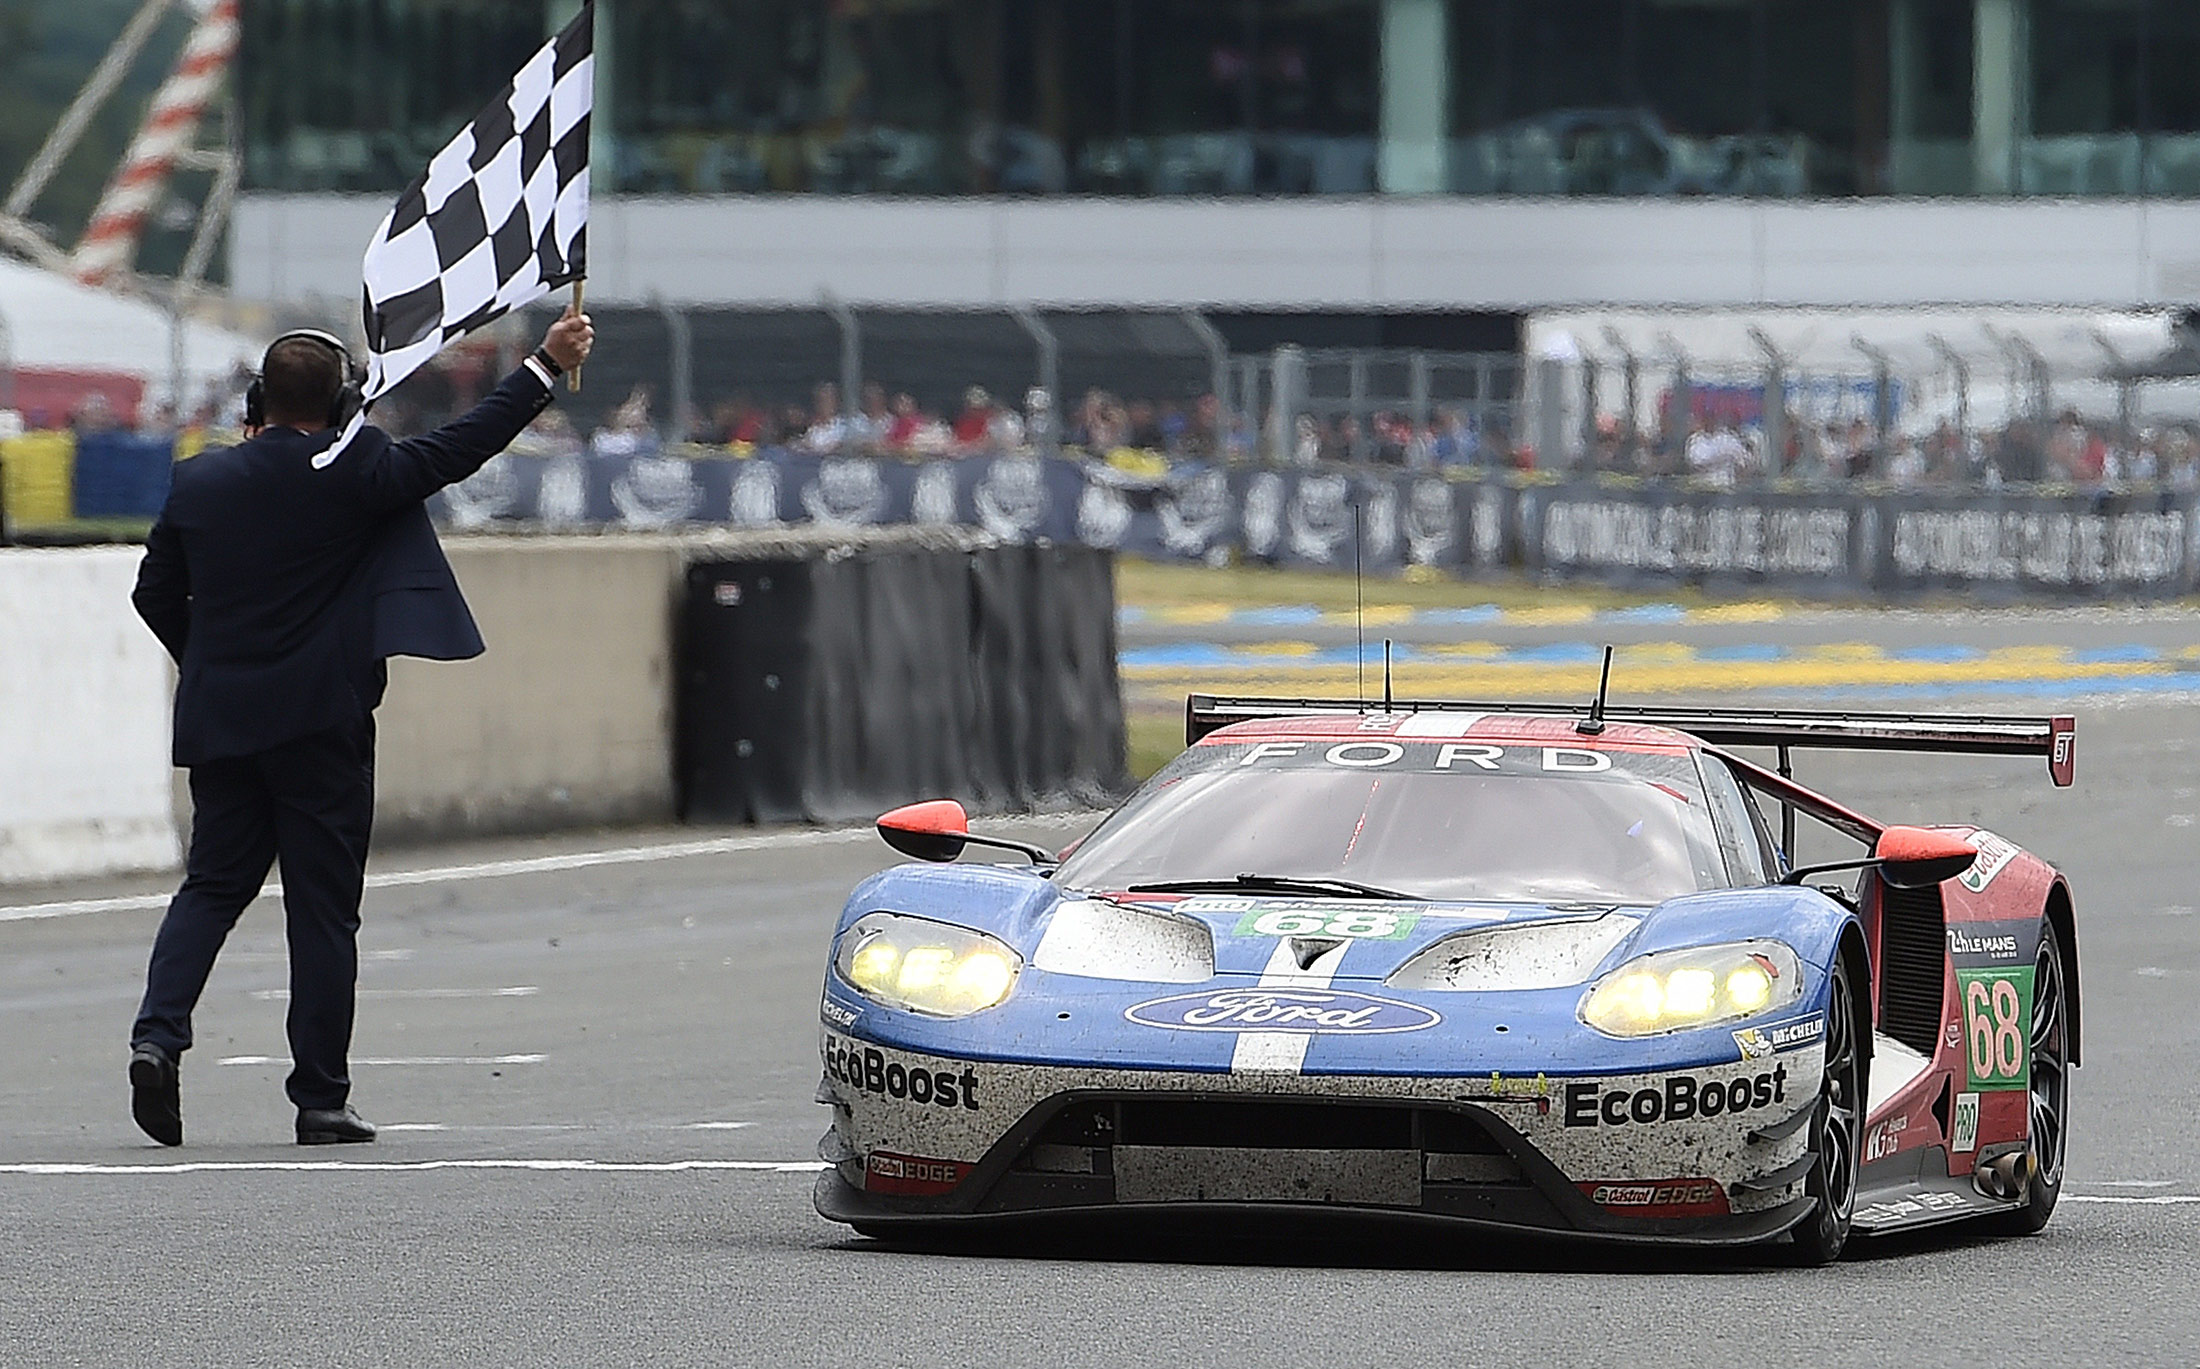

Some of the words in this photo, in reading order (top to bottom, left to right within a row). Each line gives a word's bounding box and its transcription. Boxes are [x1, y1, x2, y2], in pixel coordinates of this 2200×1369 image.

[1239, 741, 1613, 772] FORD
[1253, 909, 1400, 937] 68
[1982, 936, 2017, 951] MANS
[1184, 991, 1382, 1028] Ford
[1967, 979, 2023, 1079] 68
[825, 1033, 980, 1111] EcoBoost
[1564, 1061, 1788, 1128] EcoBoost
[1955, 1102, 1976, 1143] PRO
[905, 1162, 957, 1183] EDGE
[1608, 1187, 1652, 1203] Castrol
[1653, 1185, 1717, 1204] EDGE
